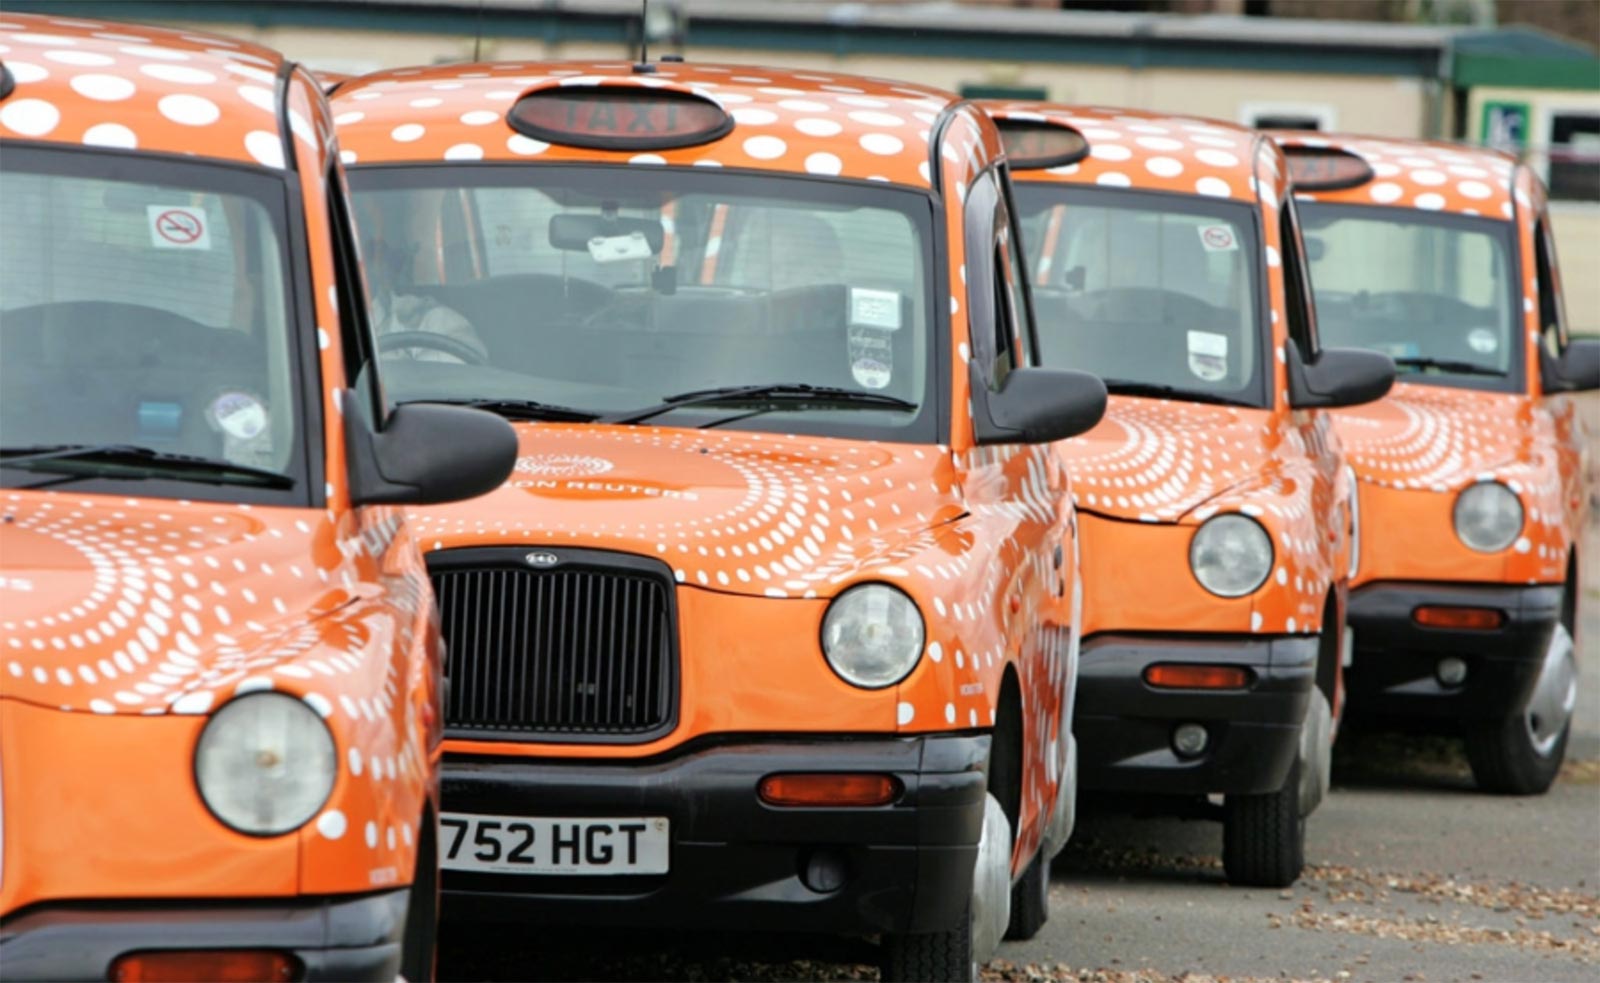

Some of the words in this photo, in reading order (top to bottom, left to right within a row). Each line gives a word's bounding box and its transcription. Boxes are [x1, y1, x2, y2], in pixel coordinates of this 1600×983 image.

[562, 97, 679, 132] TAXI
[566, 481, 699, 501] REUTERS
[551, 823, 647, 865] HGT
